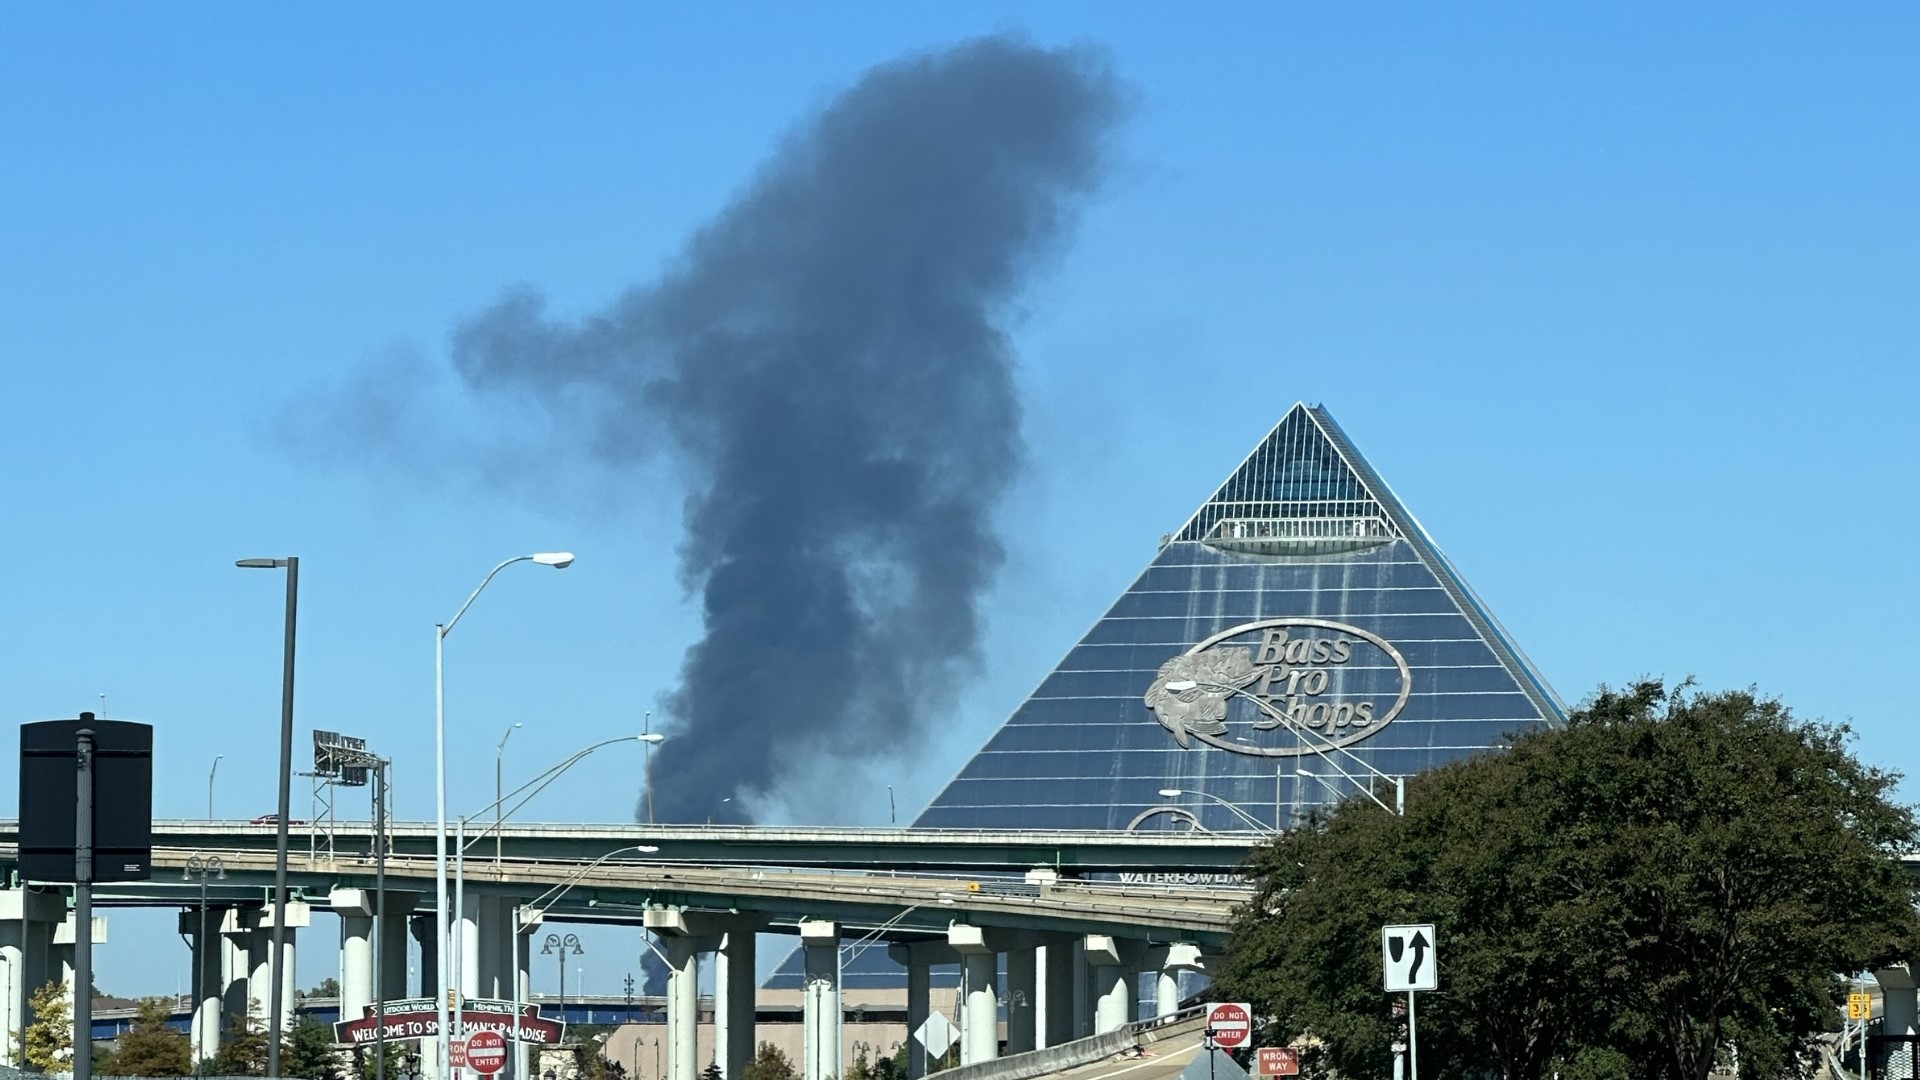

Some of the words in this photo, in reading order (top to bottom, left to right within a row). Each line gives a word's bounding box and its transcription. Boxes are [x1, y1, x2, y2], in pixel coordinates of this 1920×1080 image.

[1253, 627, 1351, 665] Bass
[1256, 664, 1328, 697] Pro
[1252, 697, 1373, 736] Shops
[383, 1005, 410, 1014] UTDOOR
[411, 1002, 435, 1011] WORLD
[504, 1004, 514, 1013] TN
[406, 1022, 423, 1035] TO
[1216, 1031, 1241, 1039] ENTER
[471, 1039, 482, 1047] DO
[486, 1038, 501, 1046] NOT
[1262, 1052, 1294, 1060] WRONG
[475, 1057, 500, 1066] ENTER
[1268, 1063, 1288, 1071] WAY
